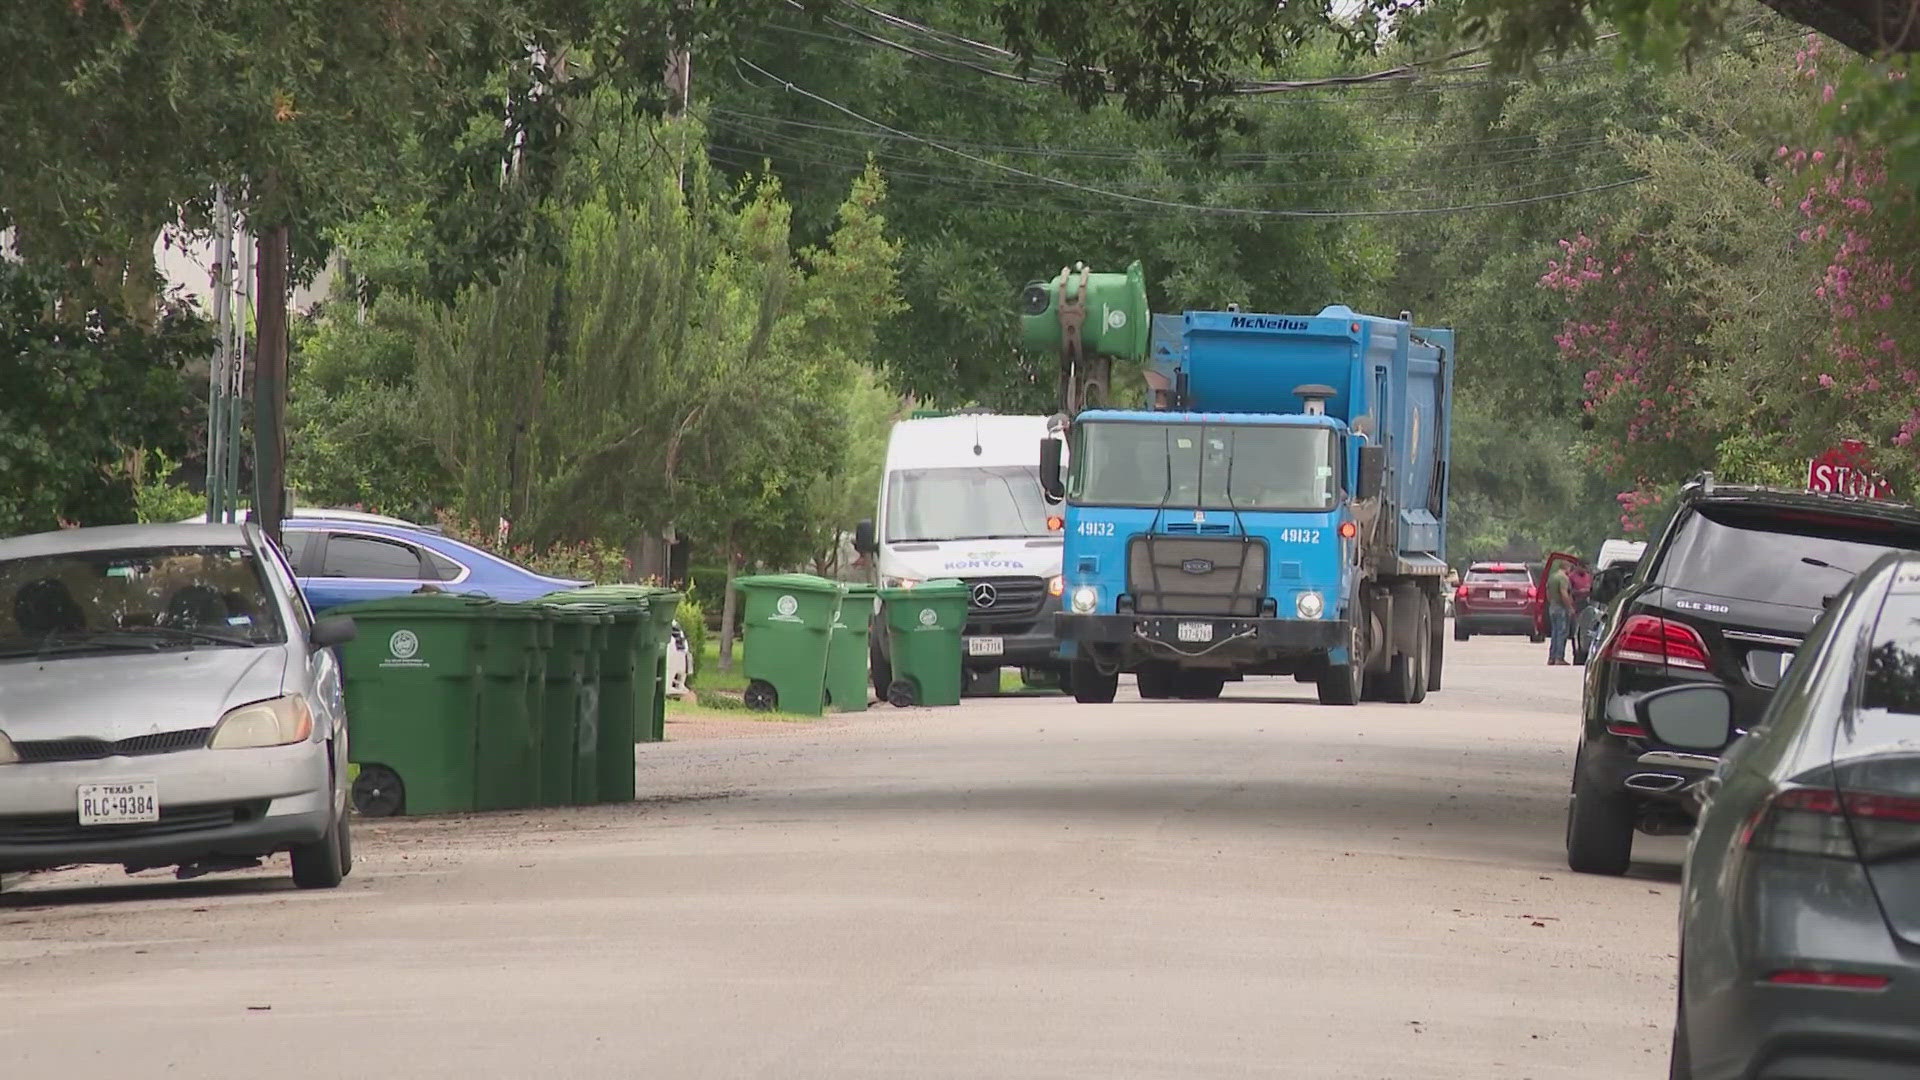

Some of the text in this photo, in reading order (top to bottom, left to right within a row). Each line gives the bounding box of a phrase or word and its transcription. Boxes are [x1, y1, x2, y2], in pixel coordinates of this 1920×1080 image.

[1231, 317, 1308, 330] McNeilus
[1077, 521, 1115, 536] 49132
[1281, 528, 1320, 544] 49132
[1676, 600, 1729, 613] GLE 350
[103, 785, 134, 795] TEXAS
